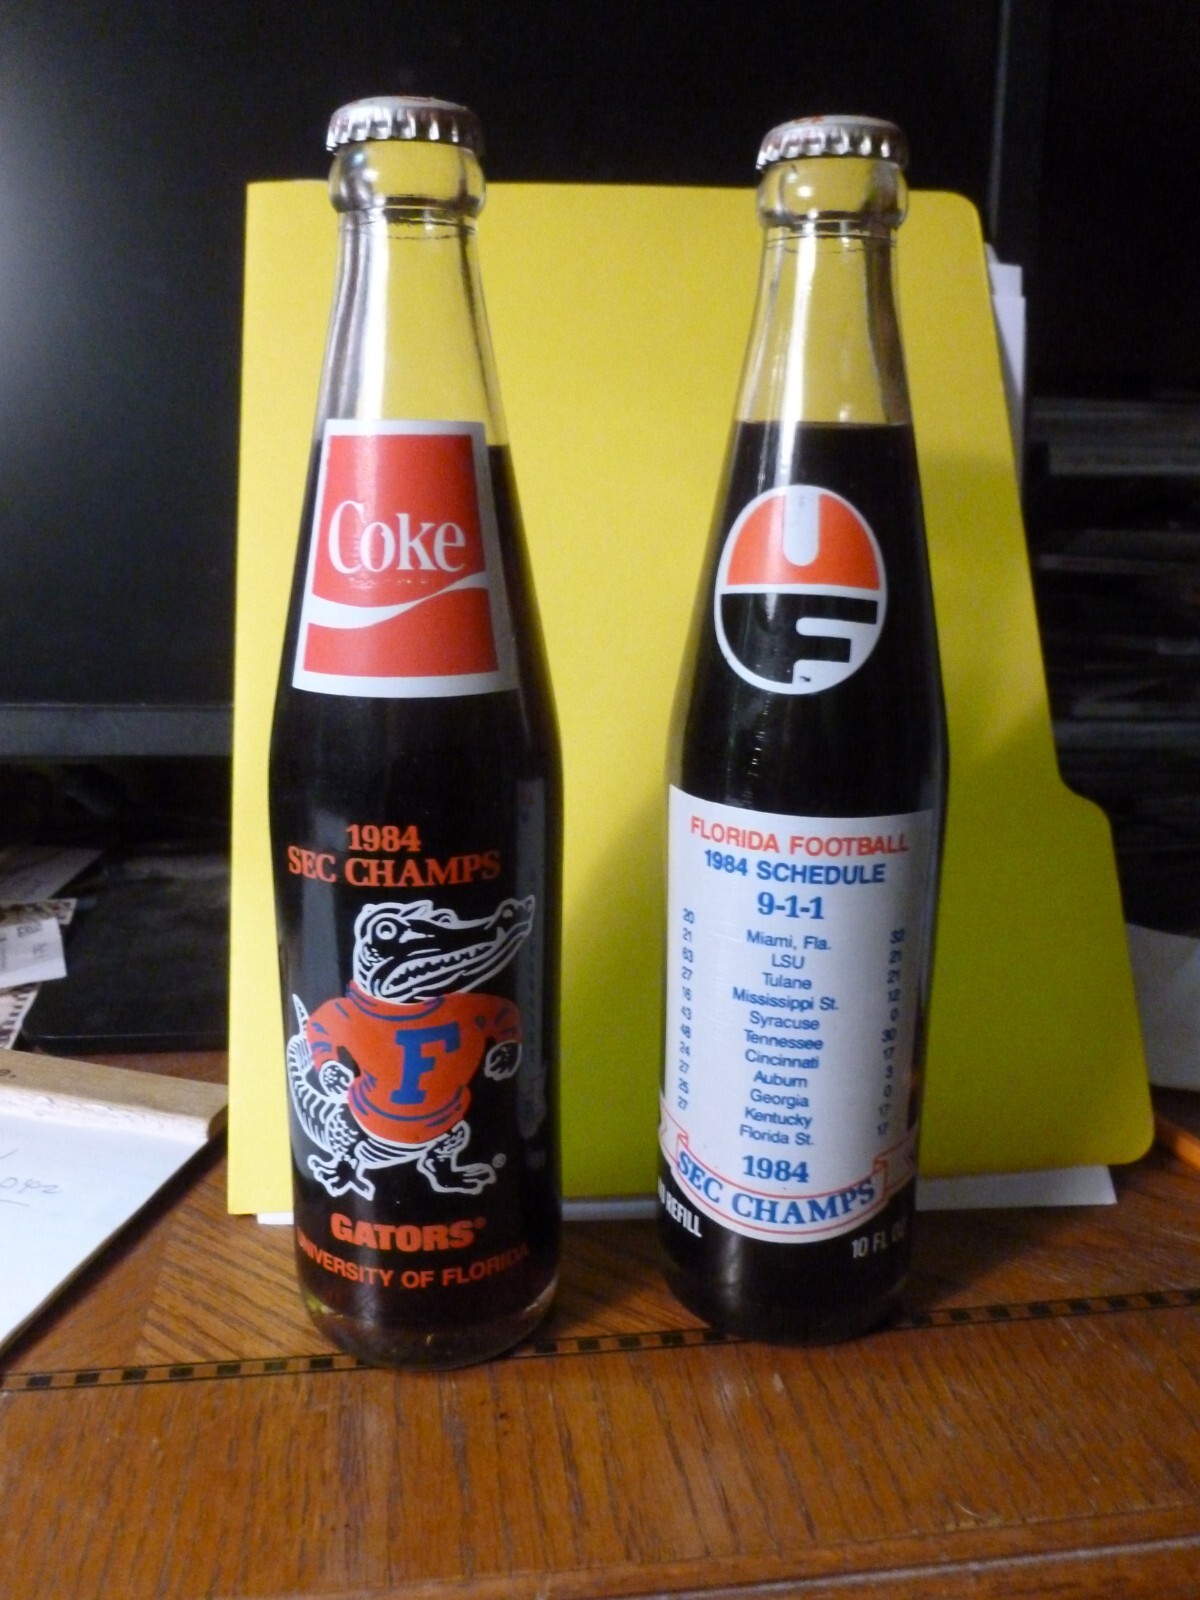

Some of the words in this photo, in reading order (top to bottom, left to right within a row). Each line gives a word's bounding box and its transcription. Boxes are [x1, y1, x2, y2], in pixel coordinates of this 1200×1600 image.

[328, 500, 466, 574] Coke
[346, 824, 421, 852] 1984
[690, 816, 780, 854] FLORIDA
[789, 834, 909, 857] FOOTBALL
[288, 845, 337, 883] SEC
[344, 850, 501, 887] CHAMPS
[704, 849, 748, 876] 1984
[756, 860, 887, 885] SCHEDULE
[757, 891, 825, 920] 9-1-1
[746, 929, 798, 950] Miami,
[803, 935, 832, 950] Fla.
[771, 953, 806, 970] LSU
[762, 972, 813, 990] Tulane
[732, 986, 814, 1012] Mississippi
[819, 996, 839, 1011] St.
[749, 1010, 820, 1031] Syracuse
[743, 1028, 824, 1050] Tennessee
[390, 1022, 460, 1105] F
[744, 1049, 820, 1070] Cincinnati
[753, 1070, 808, 1088] Auburn
[750, 1089, 809, 1110] Georgia
[744, 1107, 813, 1128] Kentucky
[739, 1125, 790, 1145] Florida
[795, 1131, 815, 1146] St.
[743, 1155, 810, 1183] 1984
[677, 1152, 724, 1203] SEC
[731, 1178, 877, 1224] CHAMPS
[330, 1213, 474, 1252] GATORS
[851, 1237, 870, 1259] 10
[401, 1270, 434, 1288] OF
